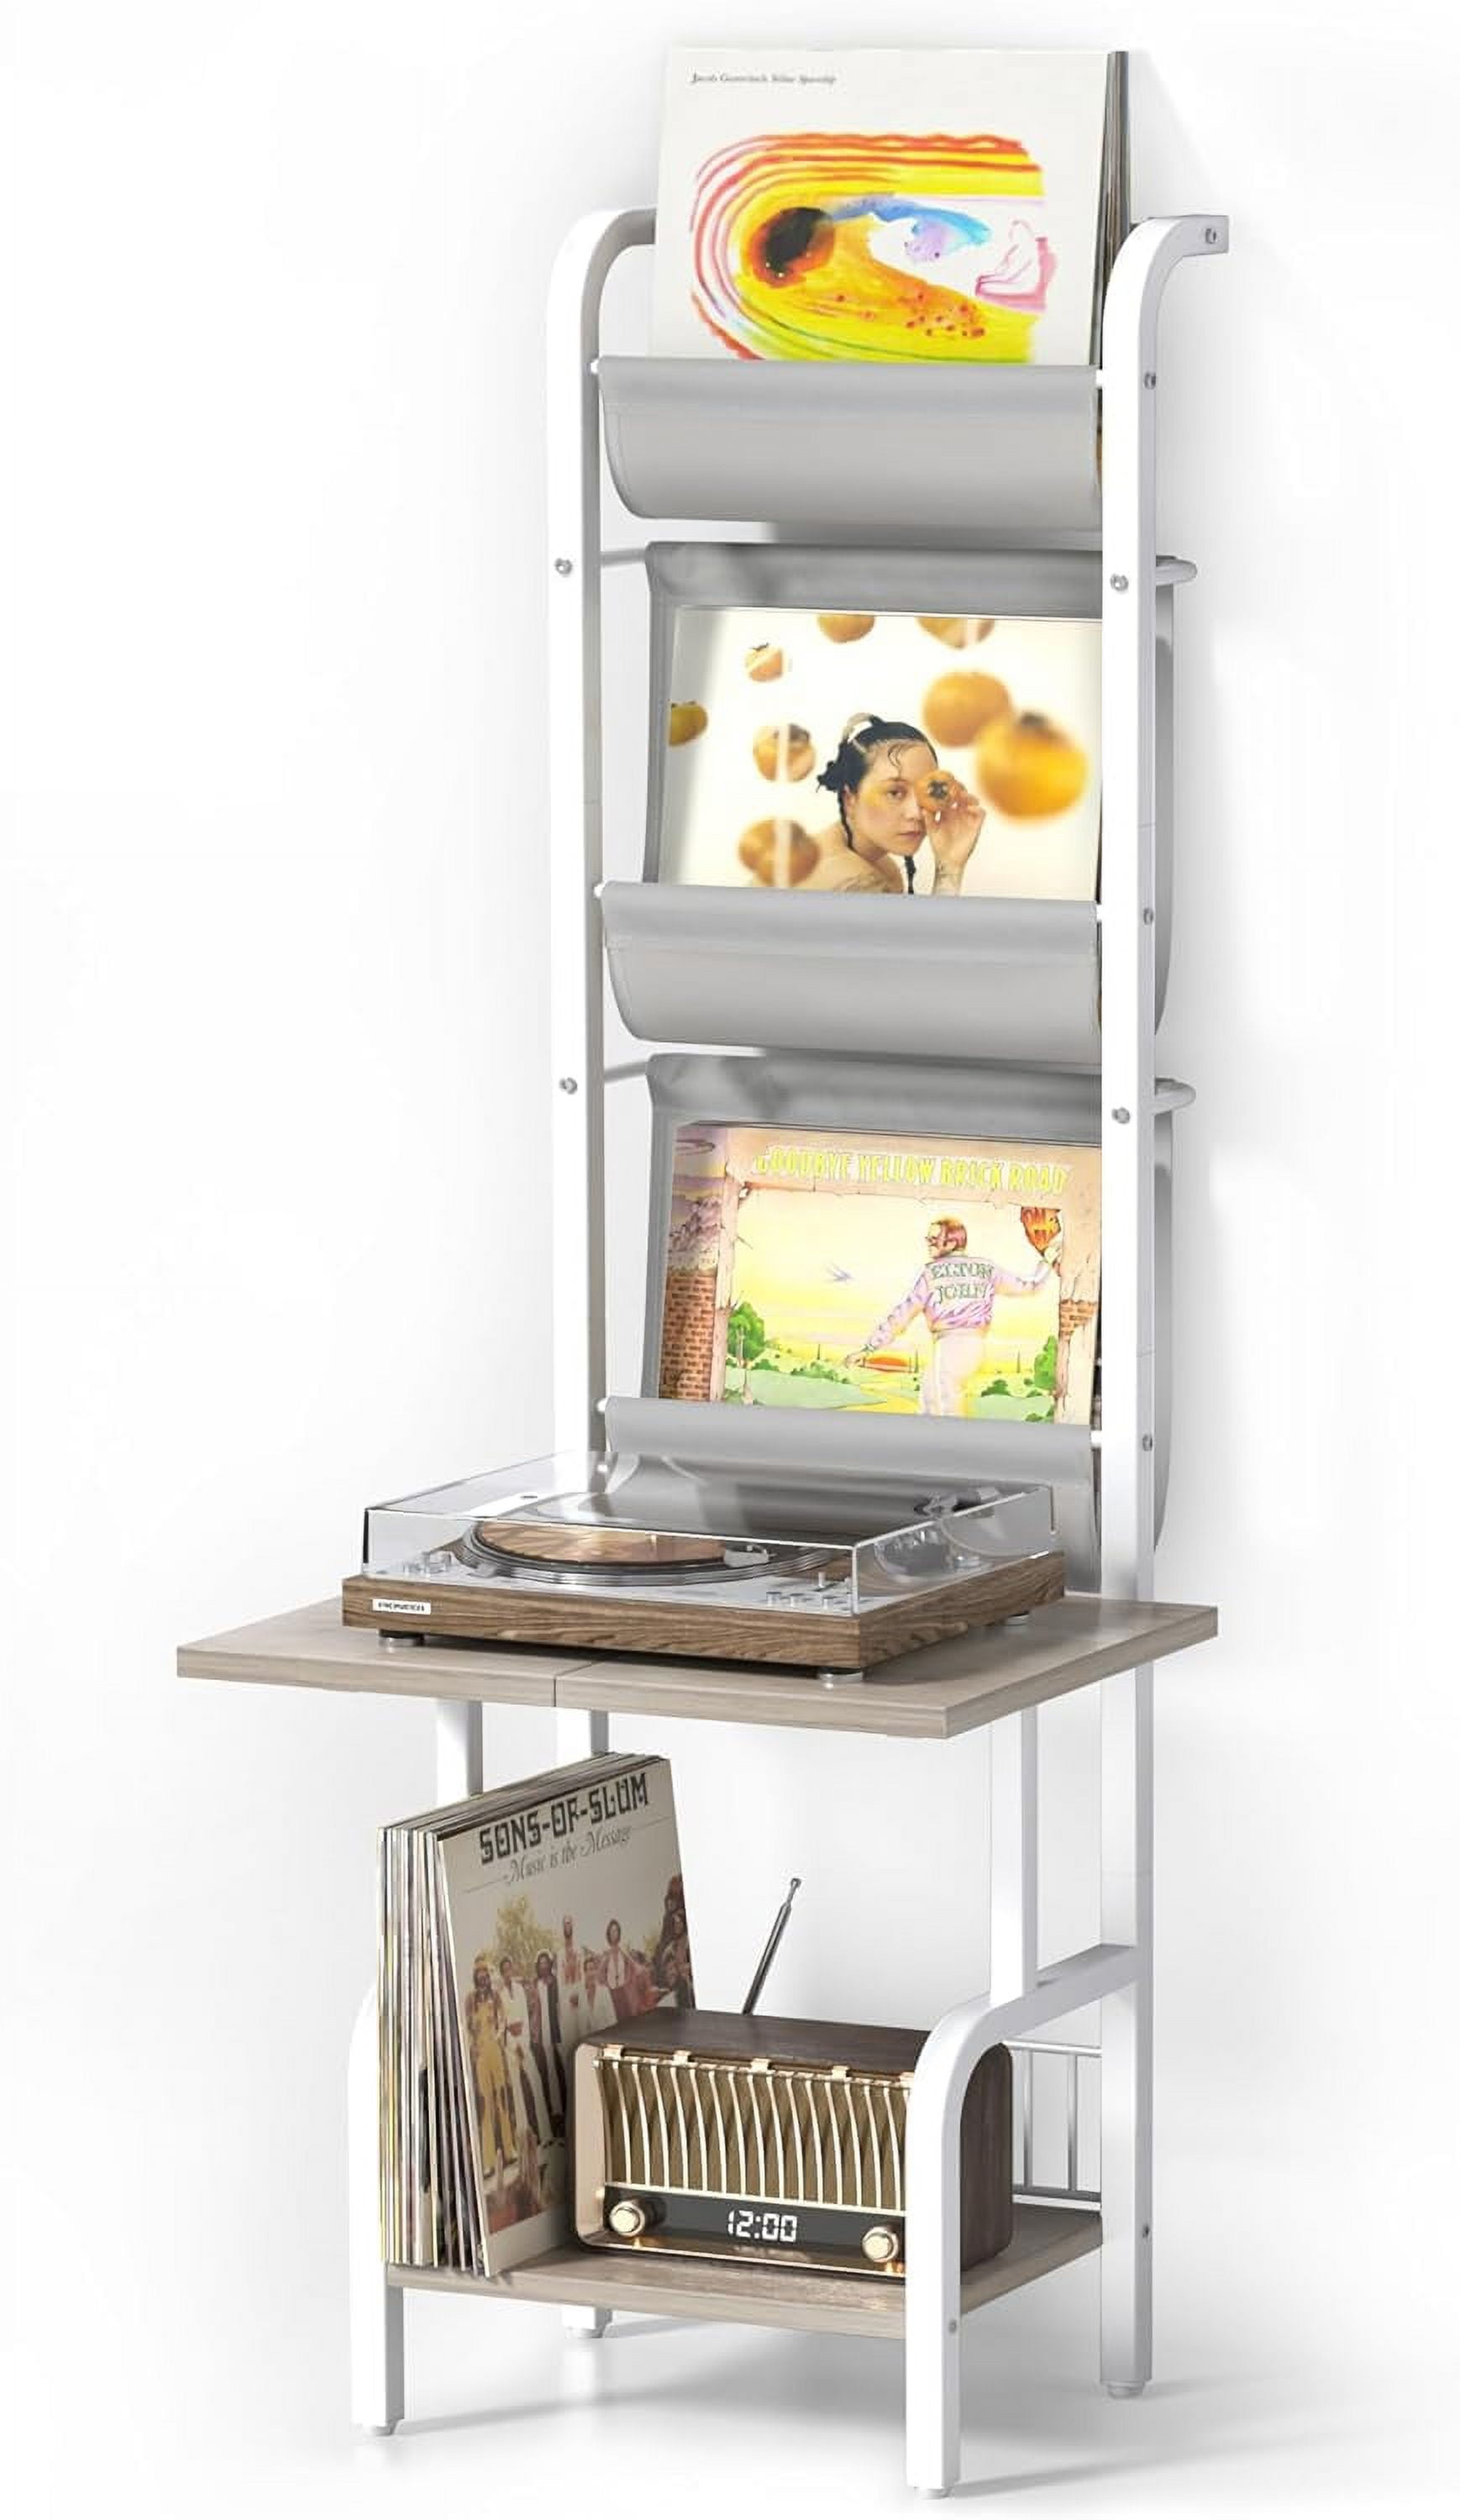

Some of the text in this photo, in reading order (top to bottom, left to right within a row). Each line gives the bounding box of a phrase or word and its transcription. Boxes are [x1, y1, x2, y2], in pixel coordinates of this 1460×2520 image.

[754, 1147, 1069, 1194] GOODBYE YELLOW BRICK ROAD
[727, 2209, 797, 2244] 12:00
